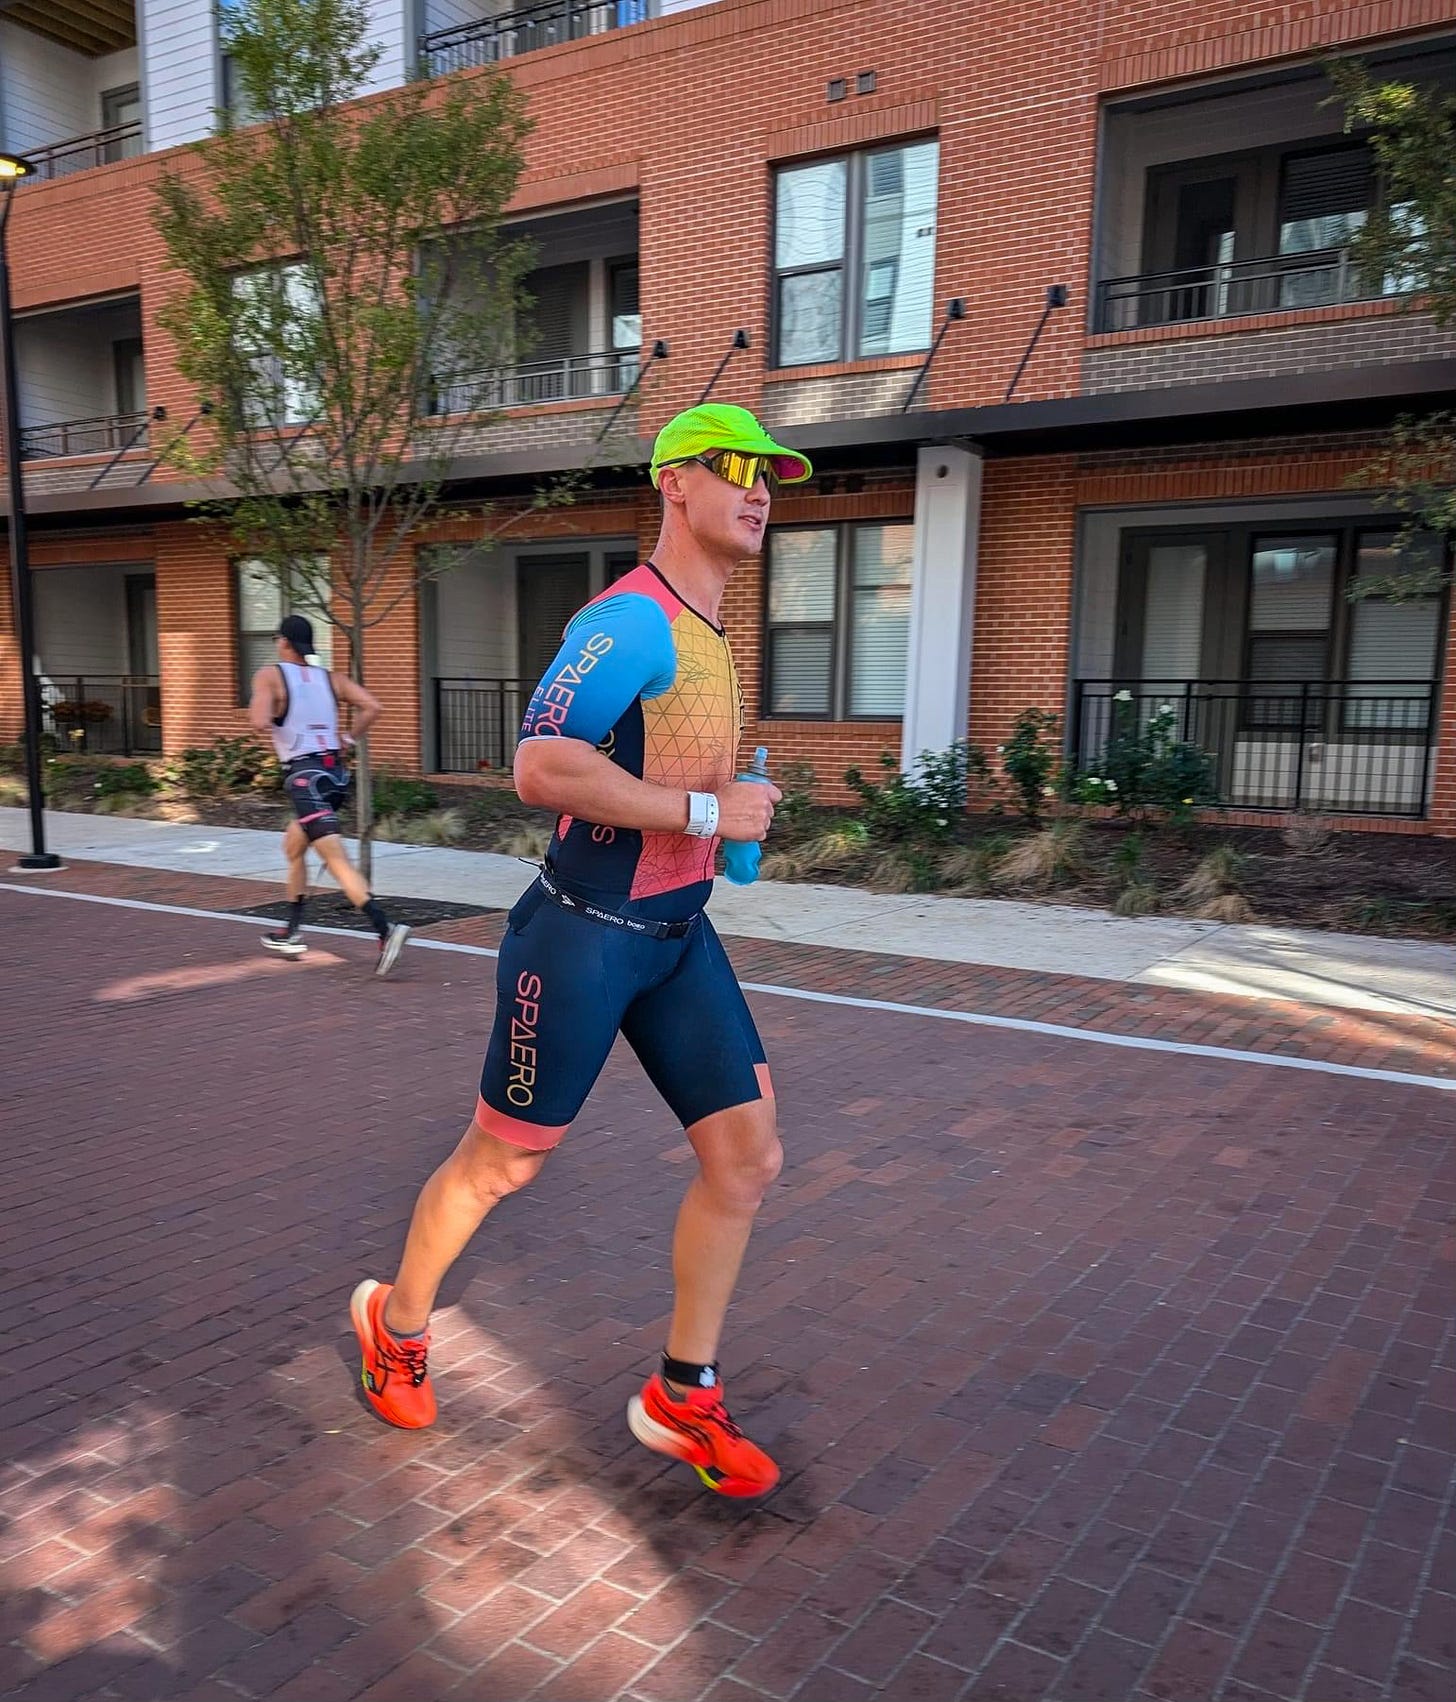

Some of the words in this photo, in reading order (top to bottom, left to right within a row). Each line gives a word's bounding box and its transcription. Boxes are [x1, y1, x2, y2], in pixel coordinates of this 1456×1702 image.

[521, 686, 545, 732] ELITE
[585, 907, 624, 925] SPAERO
[506, 970, 542, 1107] SPAERO
